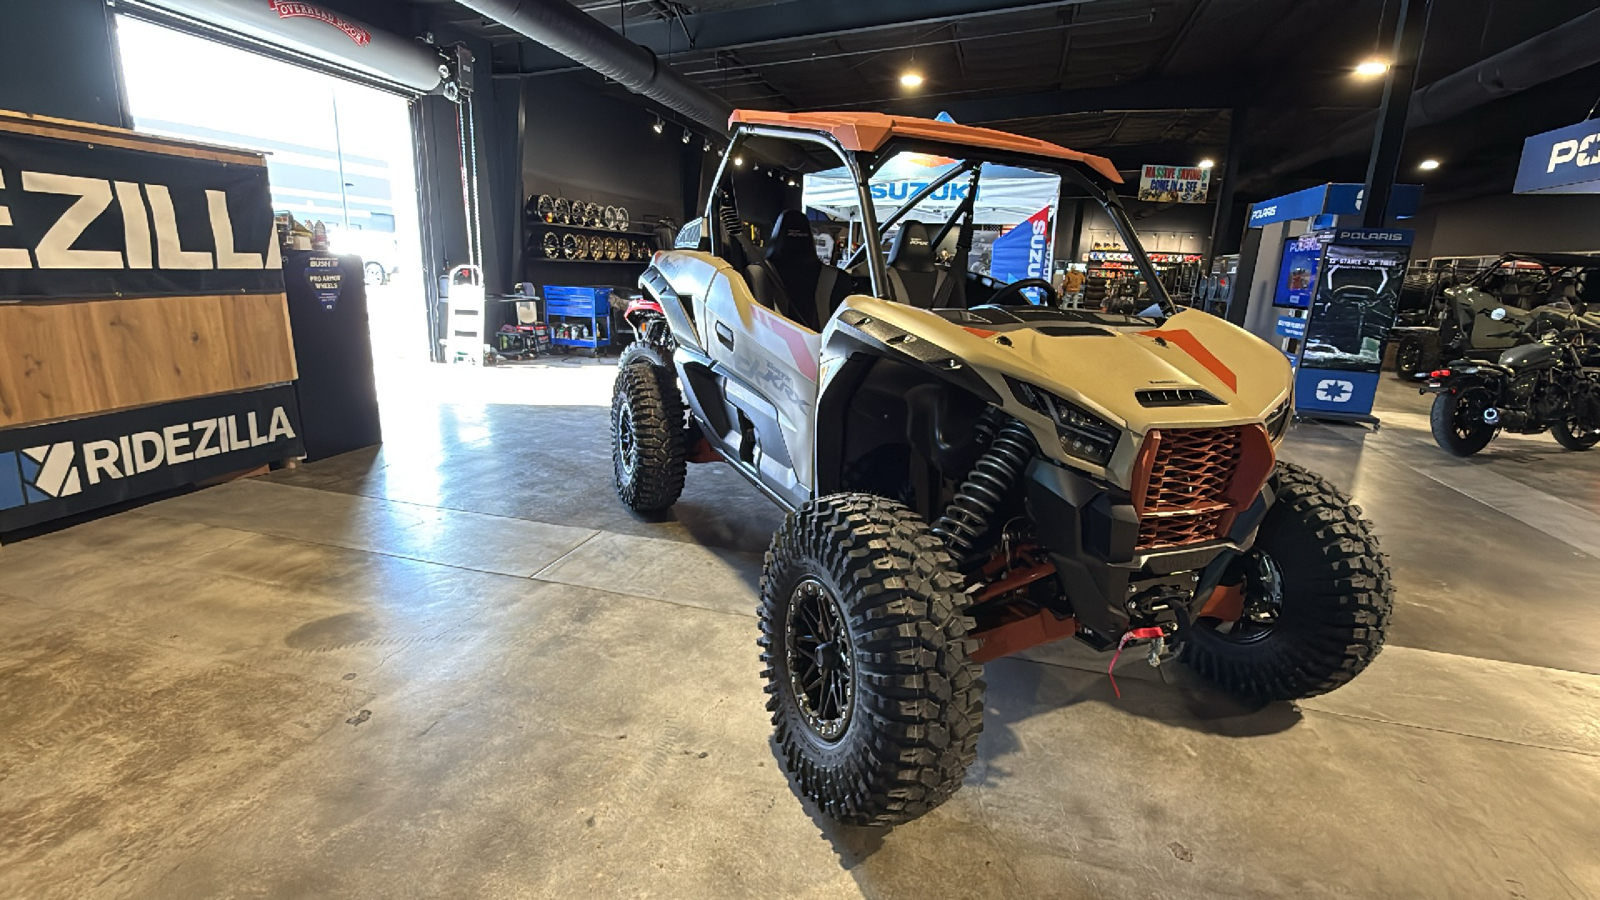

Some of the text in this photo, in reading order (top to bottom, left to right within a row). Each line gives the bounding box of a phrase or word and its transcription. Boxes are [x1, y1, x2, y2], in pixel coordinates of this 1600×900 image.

[870, 182, 980, 201] SUZUKI
[1151, 179, 1170, 192] COME
[1170, 180, 1178, 192] IN
[1185, 181, 1198, 193] SEE
[1251, 206, 1277, 220] POLARIS
[1340, 231, 1403, 241] POLARIS
[82, 406, 297, 486] RIDEZILLA
